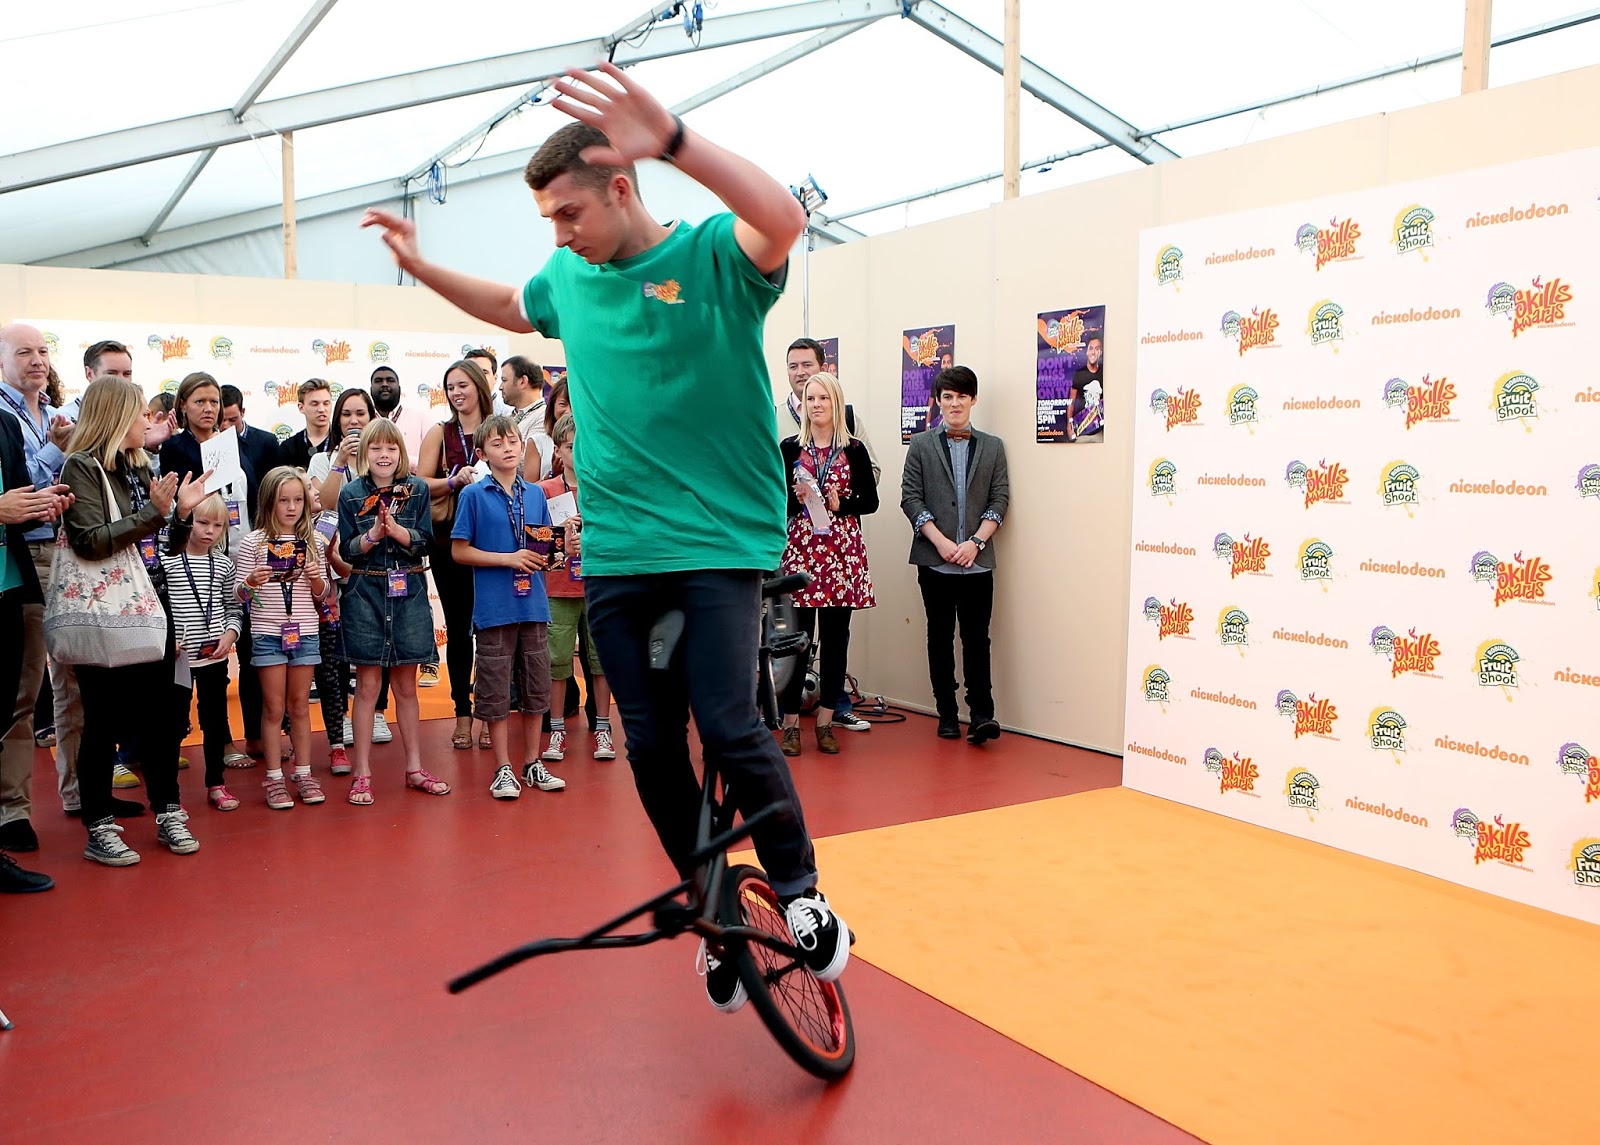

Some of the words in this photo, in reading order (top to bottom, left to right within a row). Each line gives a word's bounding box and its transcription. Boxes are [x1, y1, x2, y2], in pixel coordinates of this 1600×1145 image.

[1466, 203, 1568, 228] nickelodeon
[1316, 218, 1361, 255] Skills
[1398, 223, 1428, 241] Fruit
[1398, 234, 1431, 251] Shoot
[1205, 247, 1275, 265] nickelodeon
[1316, 240, 1356, 271] Awards
[1159, 259, 1179, 274] Fruit
[1159, 270, 1181, 284] Shoot
[1491, 294, 1511, 306] Fruit
[1514, 279, 1573, 318] Skills
[1371, 306, 1460, 325] nickelodeon
[1512, 302, 1565, 338] Awards
[1239, 308, 1279, 340] Skills
[1312, 317, 1339, 331] Fruit
[1142, 330, 1203, 344] nickelodeon
[1239, 329, 1274, 357] Awards
[1312, 329, 1340, 343] Shoot
[250, 345, 300, 354] nickelodeon
[1038, 356, 1073, 370] DON'T
[903, 369, 931, 381] DON'T
[1505, 375, 1538, 389] ROBINSONS
[903, 379, 925, 391] MISS
[902, 395, 916, 406] ON
[917, 395, 929, 406] TV
[1038, 387, 1055, 399] ON
[1055, 387, 1070, 399] TV
[1406, 378, 1457, 412] Skills
[1497, 391, 1531, 407] Fruit
[1038, 399, 1073, 407] TOMORROW
[1166, 389, 1202, 418] Skills
[1230, 400, 1253, 413] Fruit
[1283, 396, 1360, 410] nickelodeon
[1038, 414, 1056, 424] 5PM
[1230, 410, 1256, 423] Shoot
[1406, 399, 1451, 431] Awards
[1498, 404, 1535, 419] Shoot
[902, 420, 917, 429] 5PM
[1166, 408, 1198, 432] Awards
[1152, 473, 1172, 485] Fruit
[1198, 473, 1266, 486] nickelodeon
[1305, 463, 1349, 492] Skills
[1152, 483, 1174, 494] Shoot
[1385, 479, 1413, 493] Fruit
[1449, 480, 1547, 496] nickelodeon
[1305, 482, 1343, 509] Awards
[1385, 491, 1416, 504] Shoot
[1136, 541, 1196, 556] nickelodeon
[1232, 537, 1271, 564] Skills
[1231, 556, 1266, 579] Awards
[1302, 555, 1328, 568] Fruit
[1360, 558, 1445, 578] nickelodeon
[1475, 563, 1494, 573] Fruit
[1302, 566, 1329, 579] Shoot
[1496, 557, 1553, 589] Skills
[1495, 581, 1544, 607] Awards
[1159, 603, 1194, 627] Skills
[1159, 620, 1190, 641] Awards
[1221, 622, 1244, 635] Fruit
[1221, 633, 1246, 644] Shoot
[1273, 627, 1348, 649] nickelodeon
[1374, 637, 1392, 646] Fruit
[1393, 634, 1441, 659] Skills
[1486, 645, 1519, 660] ROBINSONS
[1392, 655, 1435, 678] Awards
[1480, 658, 1512, 673] Fruit
[1413, 671, 1444, 680] nickelodeon
[1480, 672, 1516, 685] Shoot
[1146, 680, 1166, 692] Fruit
[1145, 690, 1168, 700] Shoot
[1190, 687, 1257, 710] nickelodeon
[1295, 699, 1338, 724] Skills
[1378, 711, 1406, 727] ROBINSONS
[1295, 718, 1332, 739] Awards
[1373, 725, 1400, 738] Fruit
[1373, 737, 1403, 749] Shoot
[1435, 736, 1529, 765] nickelodeon
[1128, 741, 1186, 765] nickelodeon
[1563, 755, 1585, 765] Fruit
[1221, 759, 1259, 780] Skills
[1220, 777, 1254, 794] Awards
[1289, 784, 1314, 798] Fruit
[1289, 795, 1317, 808] Shoot
[1345, 797, 1428, 828] nickelodeon
[1456, 820, 1475, 830] Fruit
[1477, 823, 1531, 849] Skills
[1475, 844, 1523, 864] Awards
[1498, 860, 1533, 873] nickelodeon
